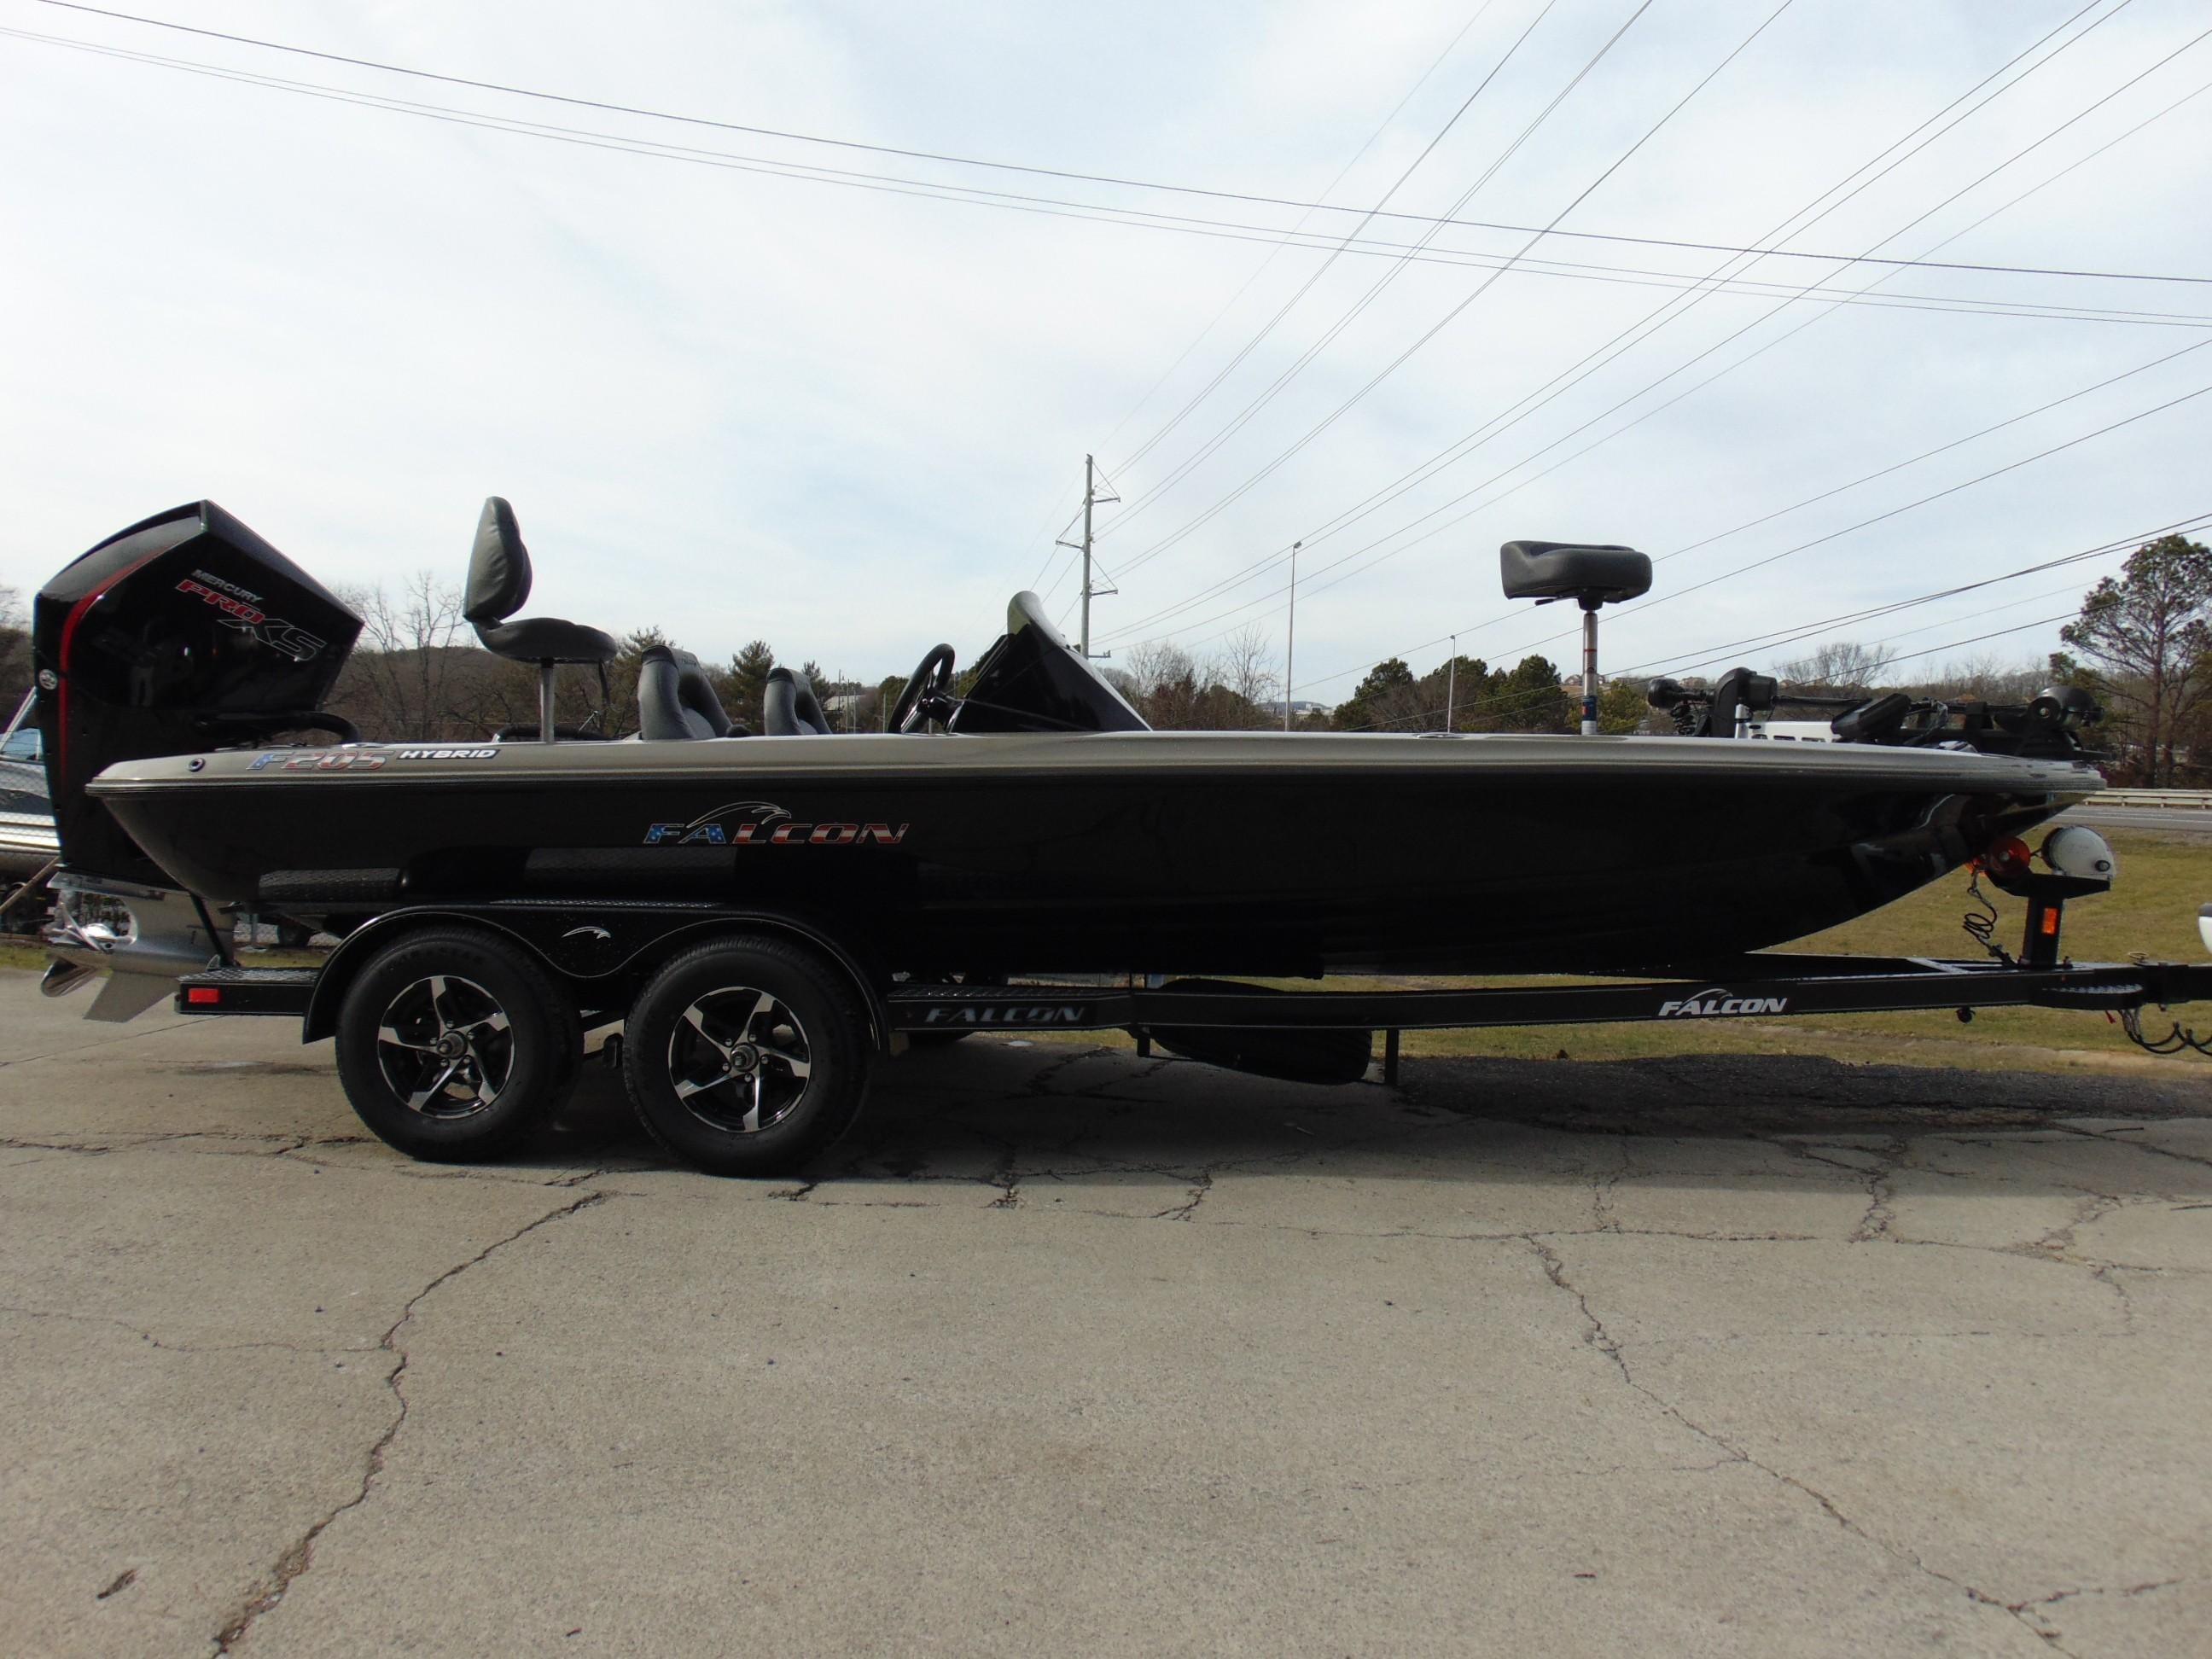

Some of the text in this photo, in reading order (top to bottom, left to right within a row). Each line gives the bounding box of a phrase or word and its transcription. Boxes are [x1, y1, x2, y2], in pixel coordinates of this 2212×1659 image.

[191, 568, 264, 602] MERCURY
[175, 579, 328, 661] PRO XS
[246, 748, 498, 770] F205 HYBRID
[643, 823, 910, 844] FALCON
[924, 1005, 1086, 1022] FALCON
[1658, 997, 1788, 1016] FALCON
